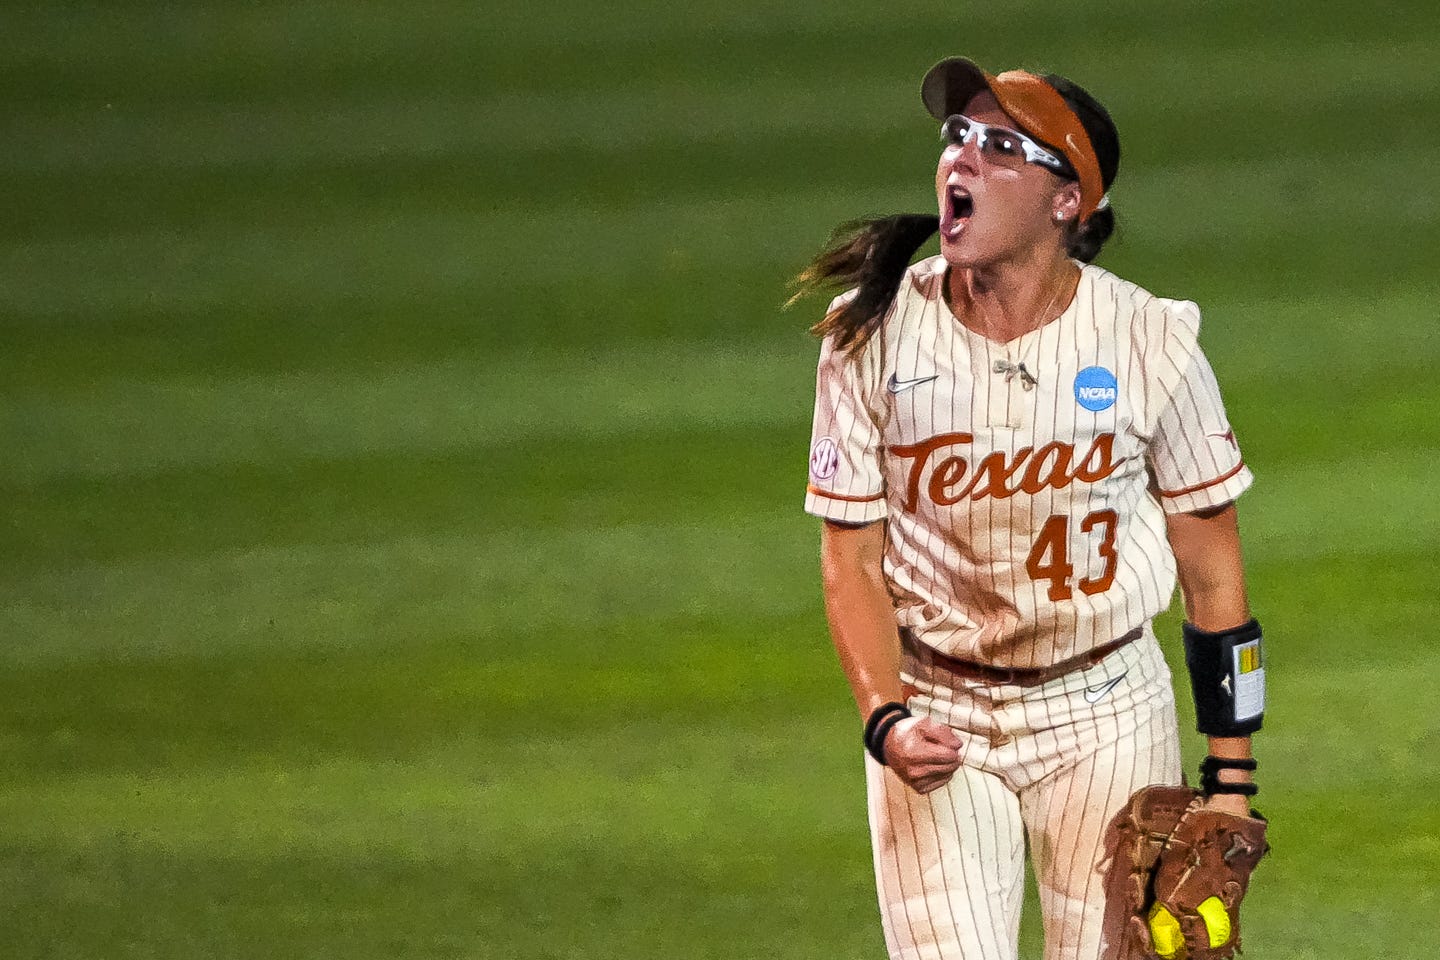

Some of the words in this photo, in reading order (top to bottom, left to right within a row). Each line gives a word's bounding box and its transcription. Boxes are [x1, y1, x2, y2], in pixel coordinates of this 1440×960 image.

[1078, 386, 1116, 400] NCAA
[889, 432, 1126, 514] Texas
[1025, 510, 1119, 602] 43
